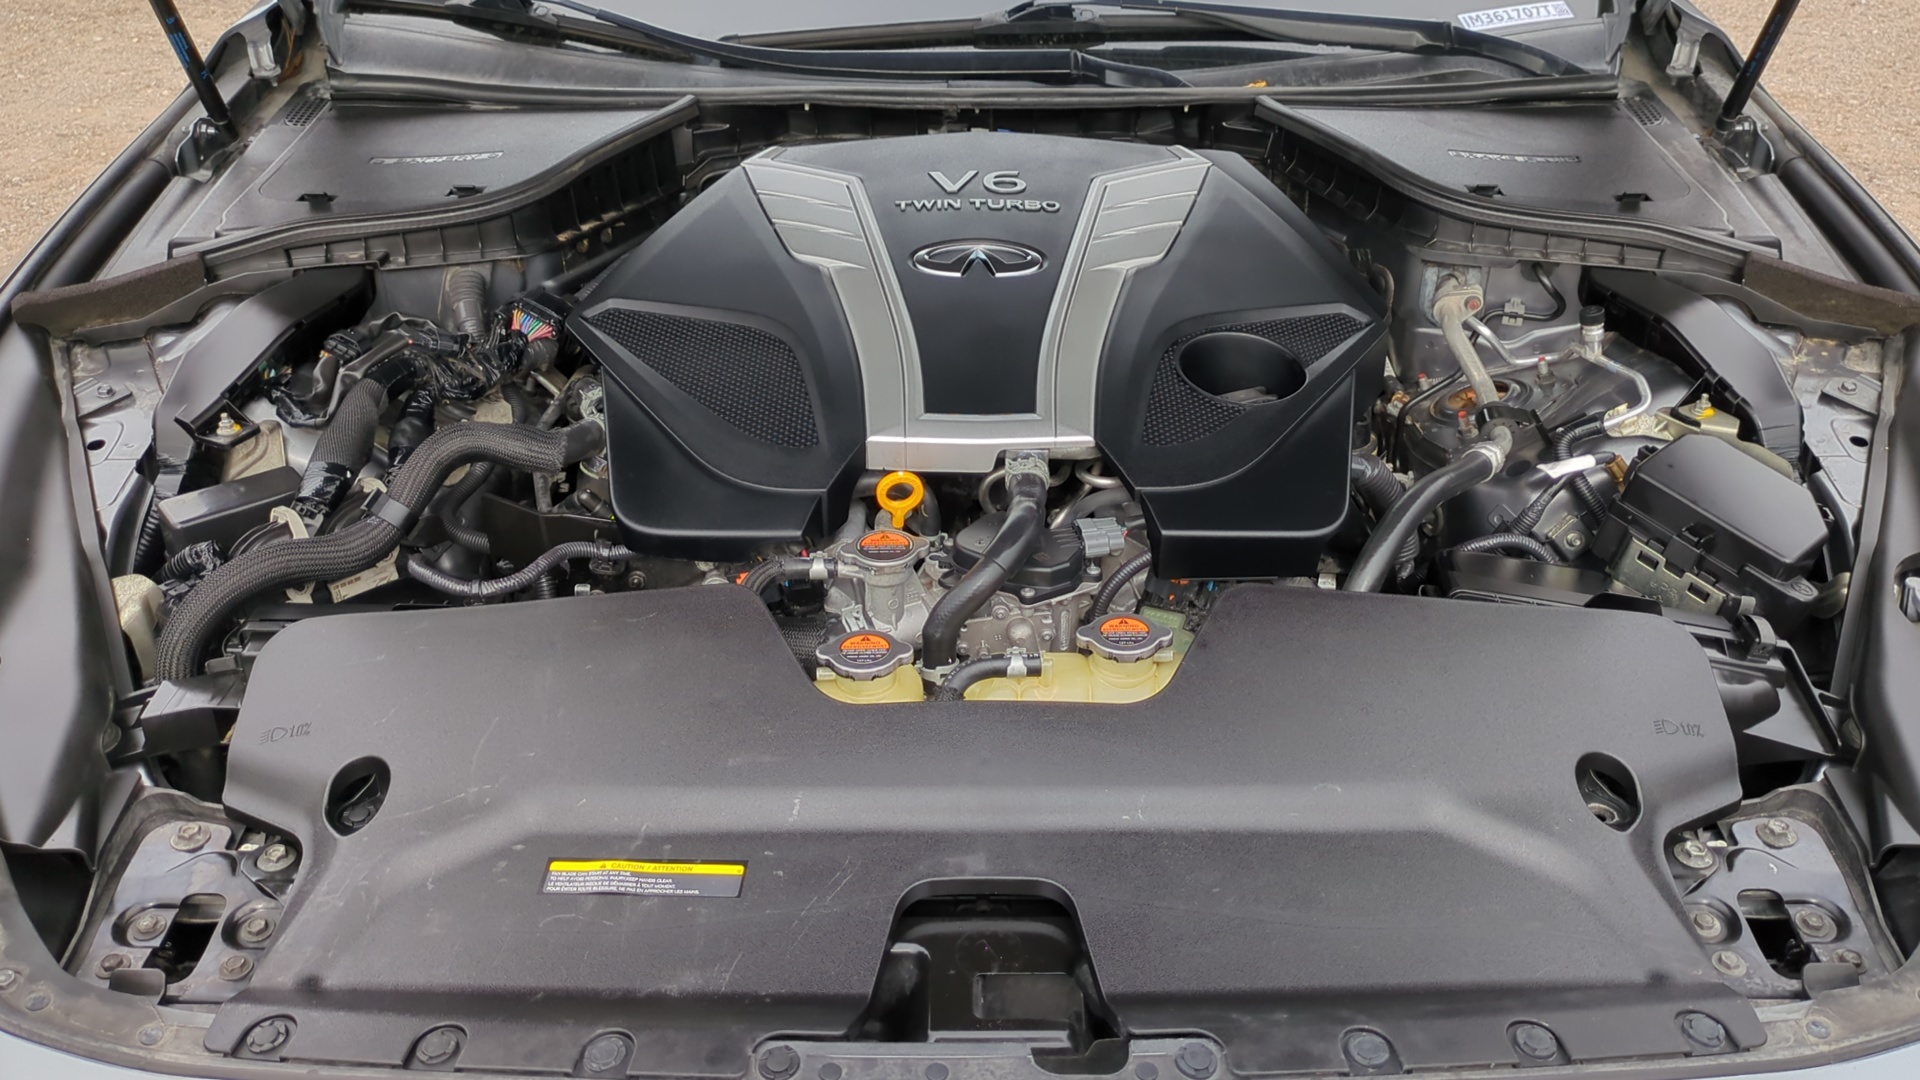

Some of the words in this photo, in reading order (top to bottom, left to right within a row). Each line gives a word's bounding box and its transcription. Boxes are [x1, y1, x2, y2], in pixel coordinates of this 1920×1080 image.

[927, 170, 1027, 193] V6
[895, 199, 962, 211] TWIN
[969, 198, 1061, 213] TURBO
